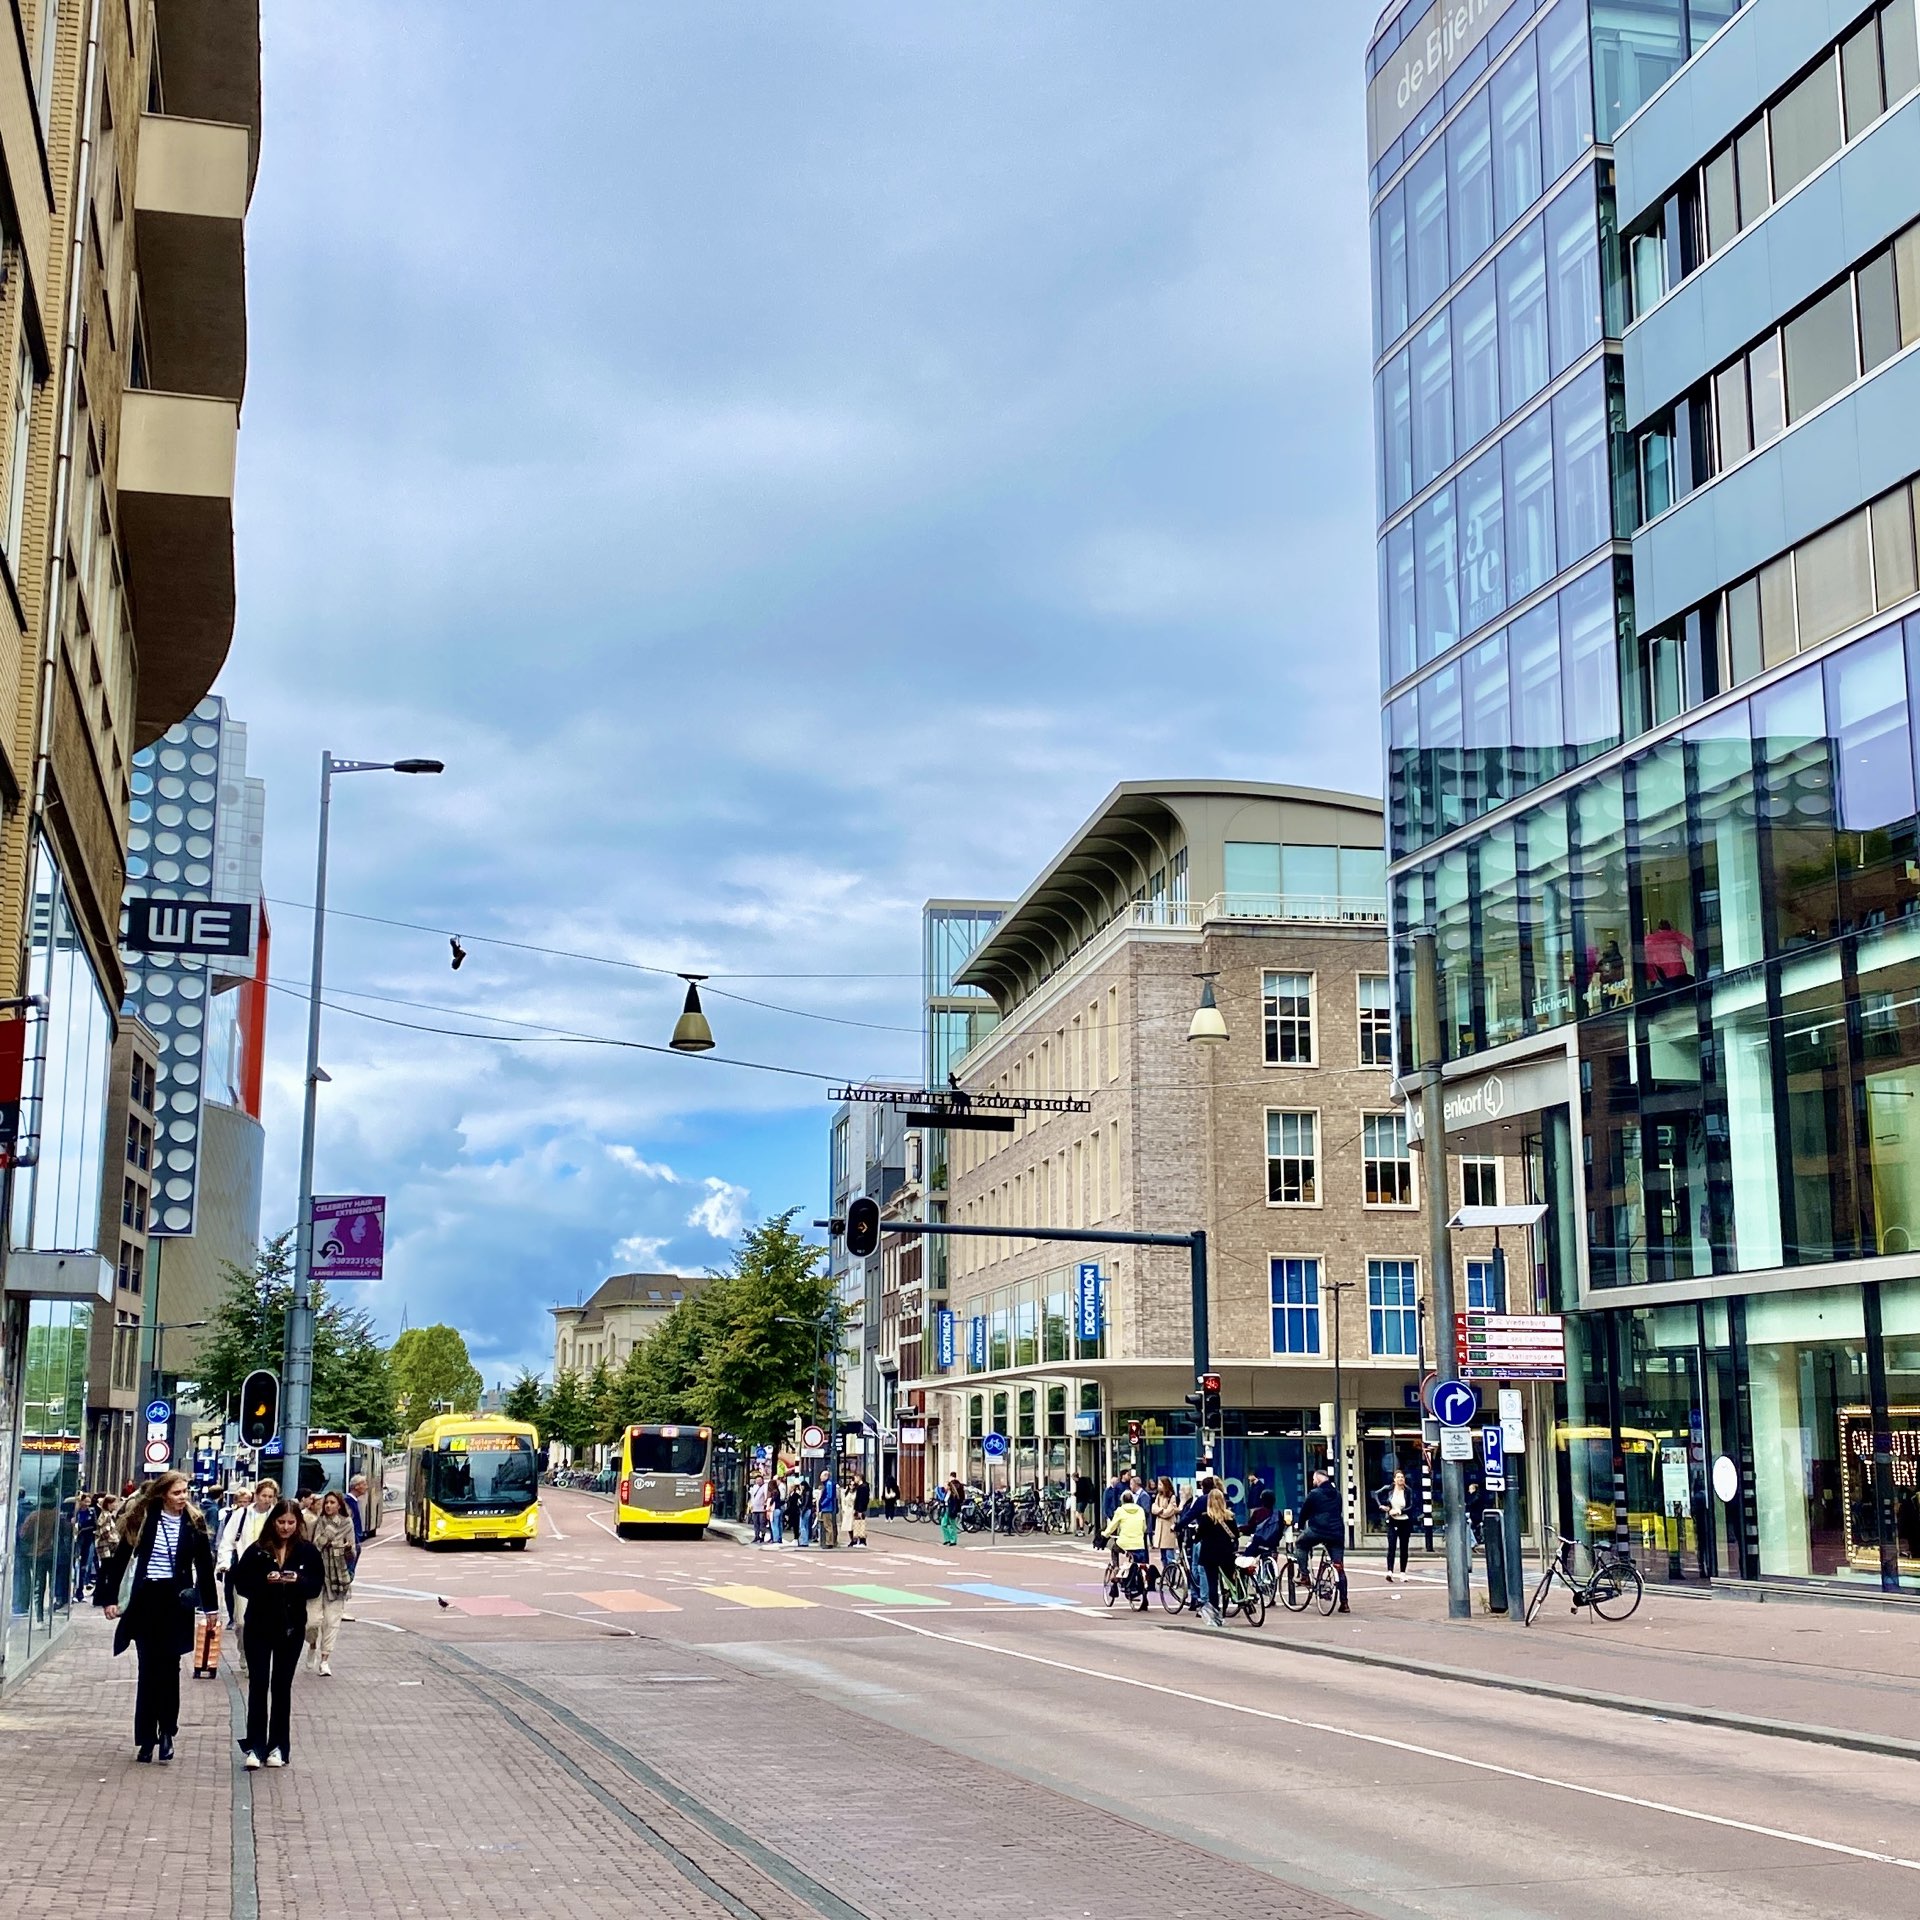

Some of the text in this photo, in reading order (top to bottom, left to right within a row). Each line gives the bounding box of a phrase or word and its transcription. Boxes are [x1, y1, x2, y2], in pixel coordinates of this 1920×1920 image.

[1397, 59, 1424, 109] de
[148, 906, 231, 946] WE
[1532, 996, 1568, 1017] kitchen
[316, 1199, 373, 1212] CELEBRITY HAIR
[335, 1205, 382, 1216] EXTENSIONS
[1084, 1268, 1096, 1335] DECATHLON
[943, 1313, 952, 1364] DECATHLON
[1486, 1431, 1498, 1455] P
